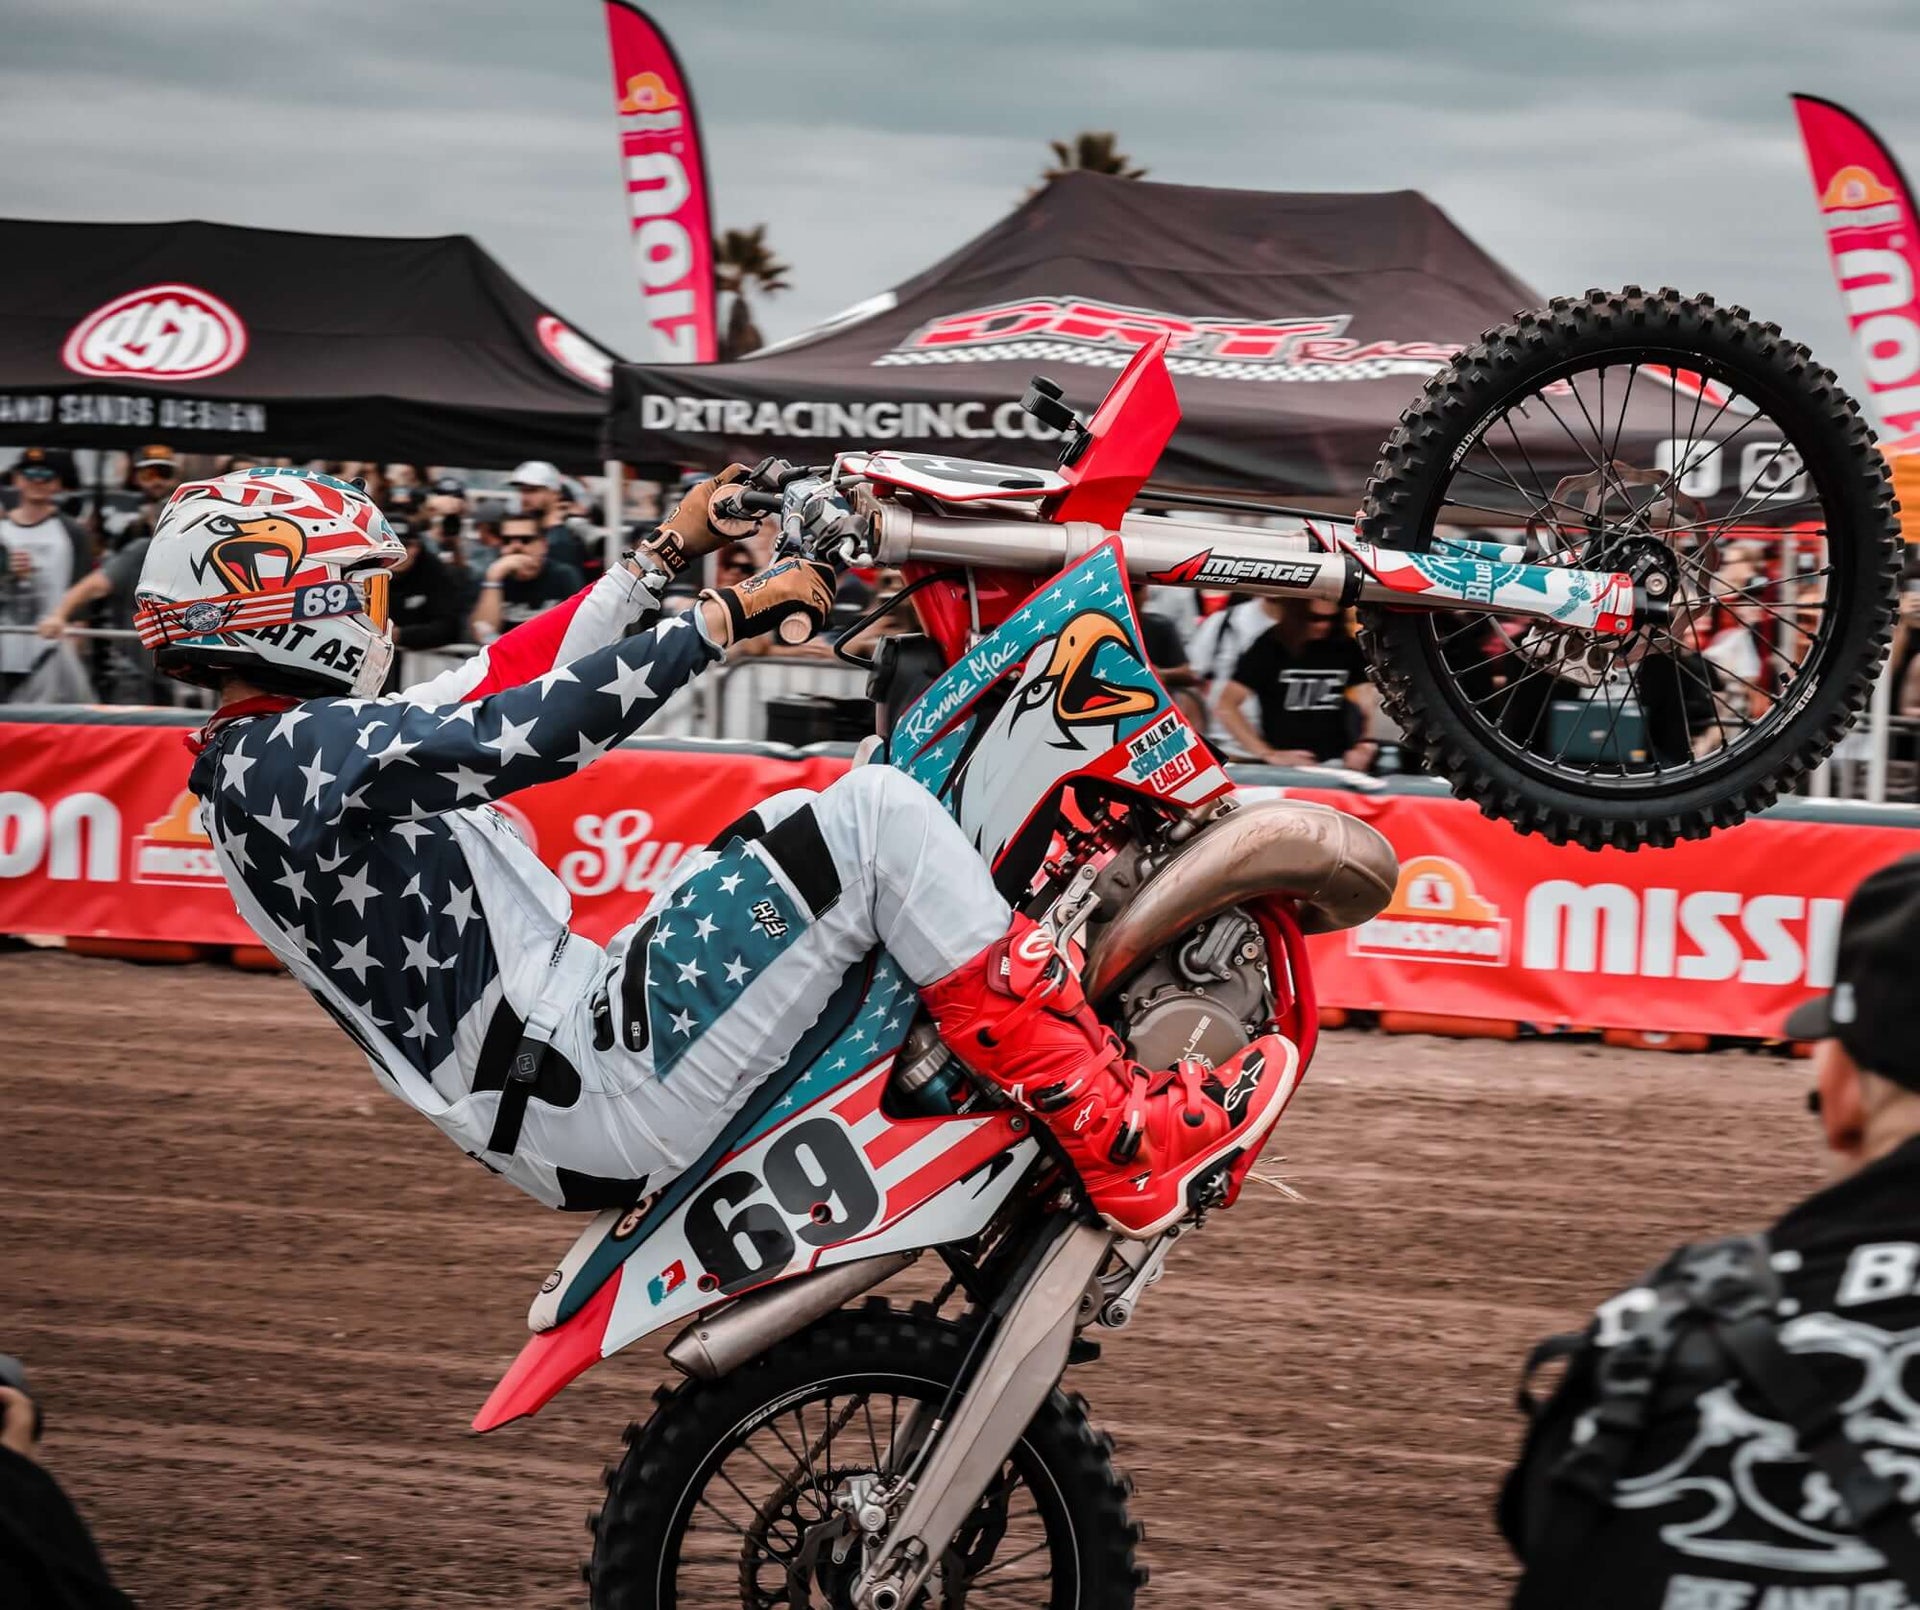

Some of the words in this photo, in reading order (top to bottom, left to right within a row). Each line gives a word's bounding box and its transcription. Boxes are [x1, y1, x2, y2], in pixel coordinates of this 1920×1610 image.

[58, 395, 153, 426] SANDS
[159, 399, 266, 433] DESIGN
[642, 394, 1100, 440] DRTRACINGINC.CO
[661, 545, 686, 569] FIST
[1201, 557, 1316, 583] MERGE
[1193, 574, 1239, 585] RACING
[1466, 561, 1493, 602] Blue
[302, 584, 351, 618] 69
[309, 638, 365, 678] AS
[905, 679, 977, 744] Ronnie
[967, 640, 1020, 682] Mac
[1130, 738, 1147, 758] THE
[1145, 729, 1162, 748] ALL
[1158, 716, 1177, 738] NEW
[1151, 752, 1192, 791] EAGLE!
[1522, 879, 1847, 989] MISSI
[684, 1117, 880, 1295] 69
